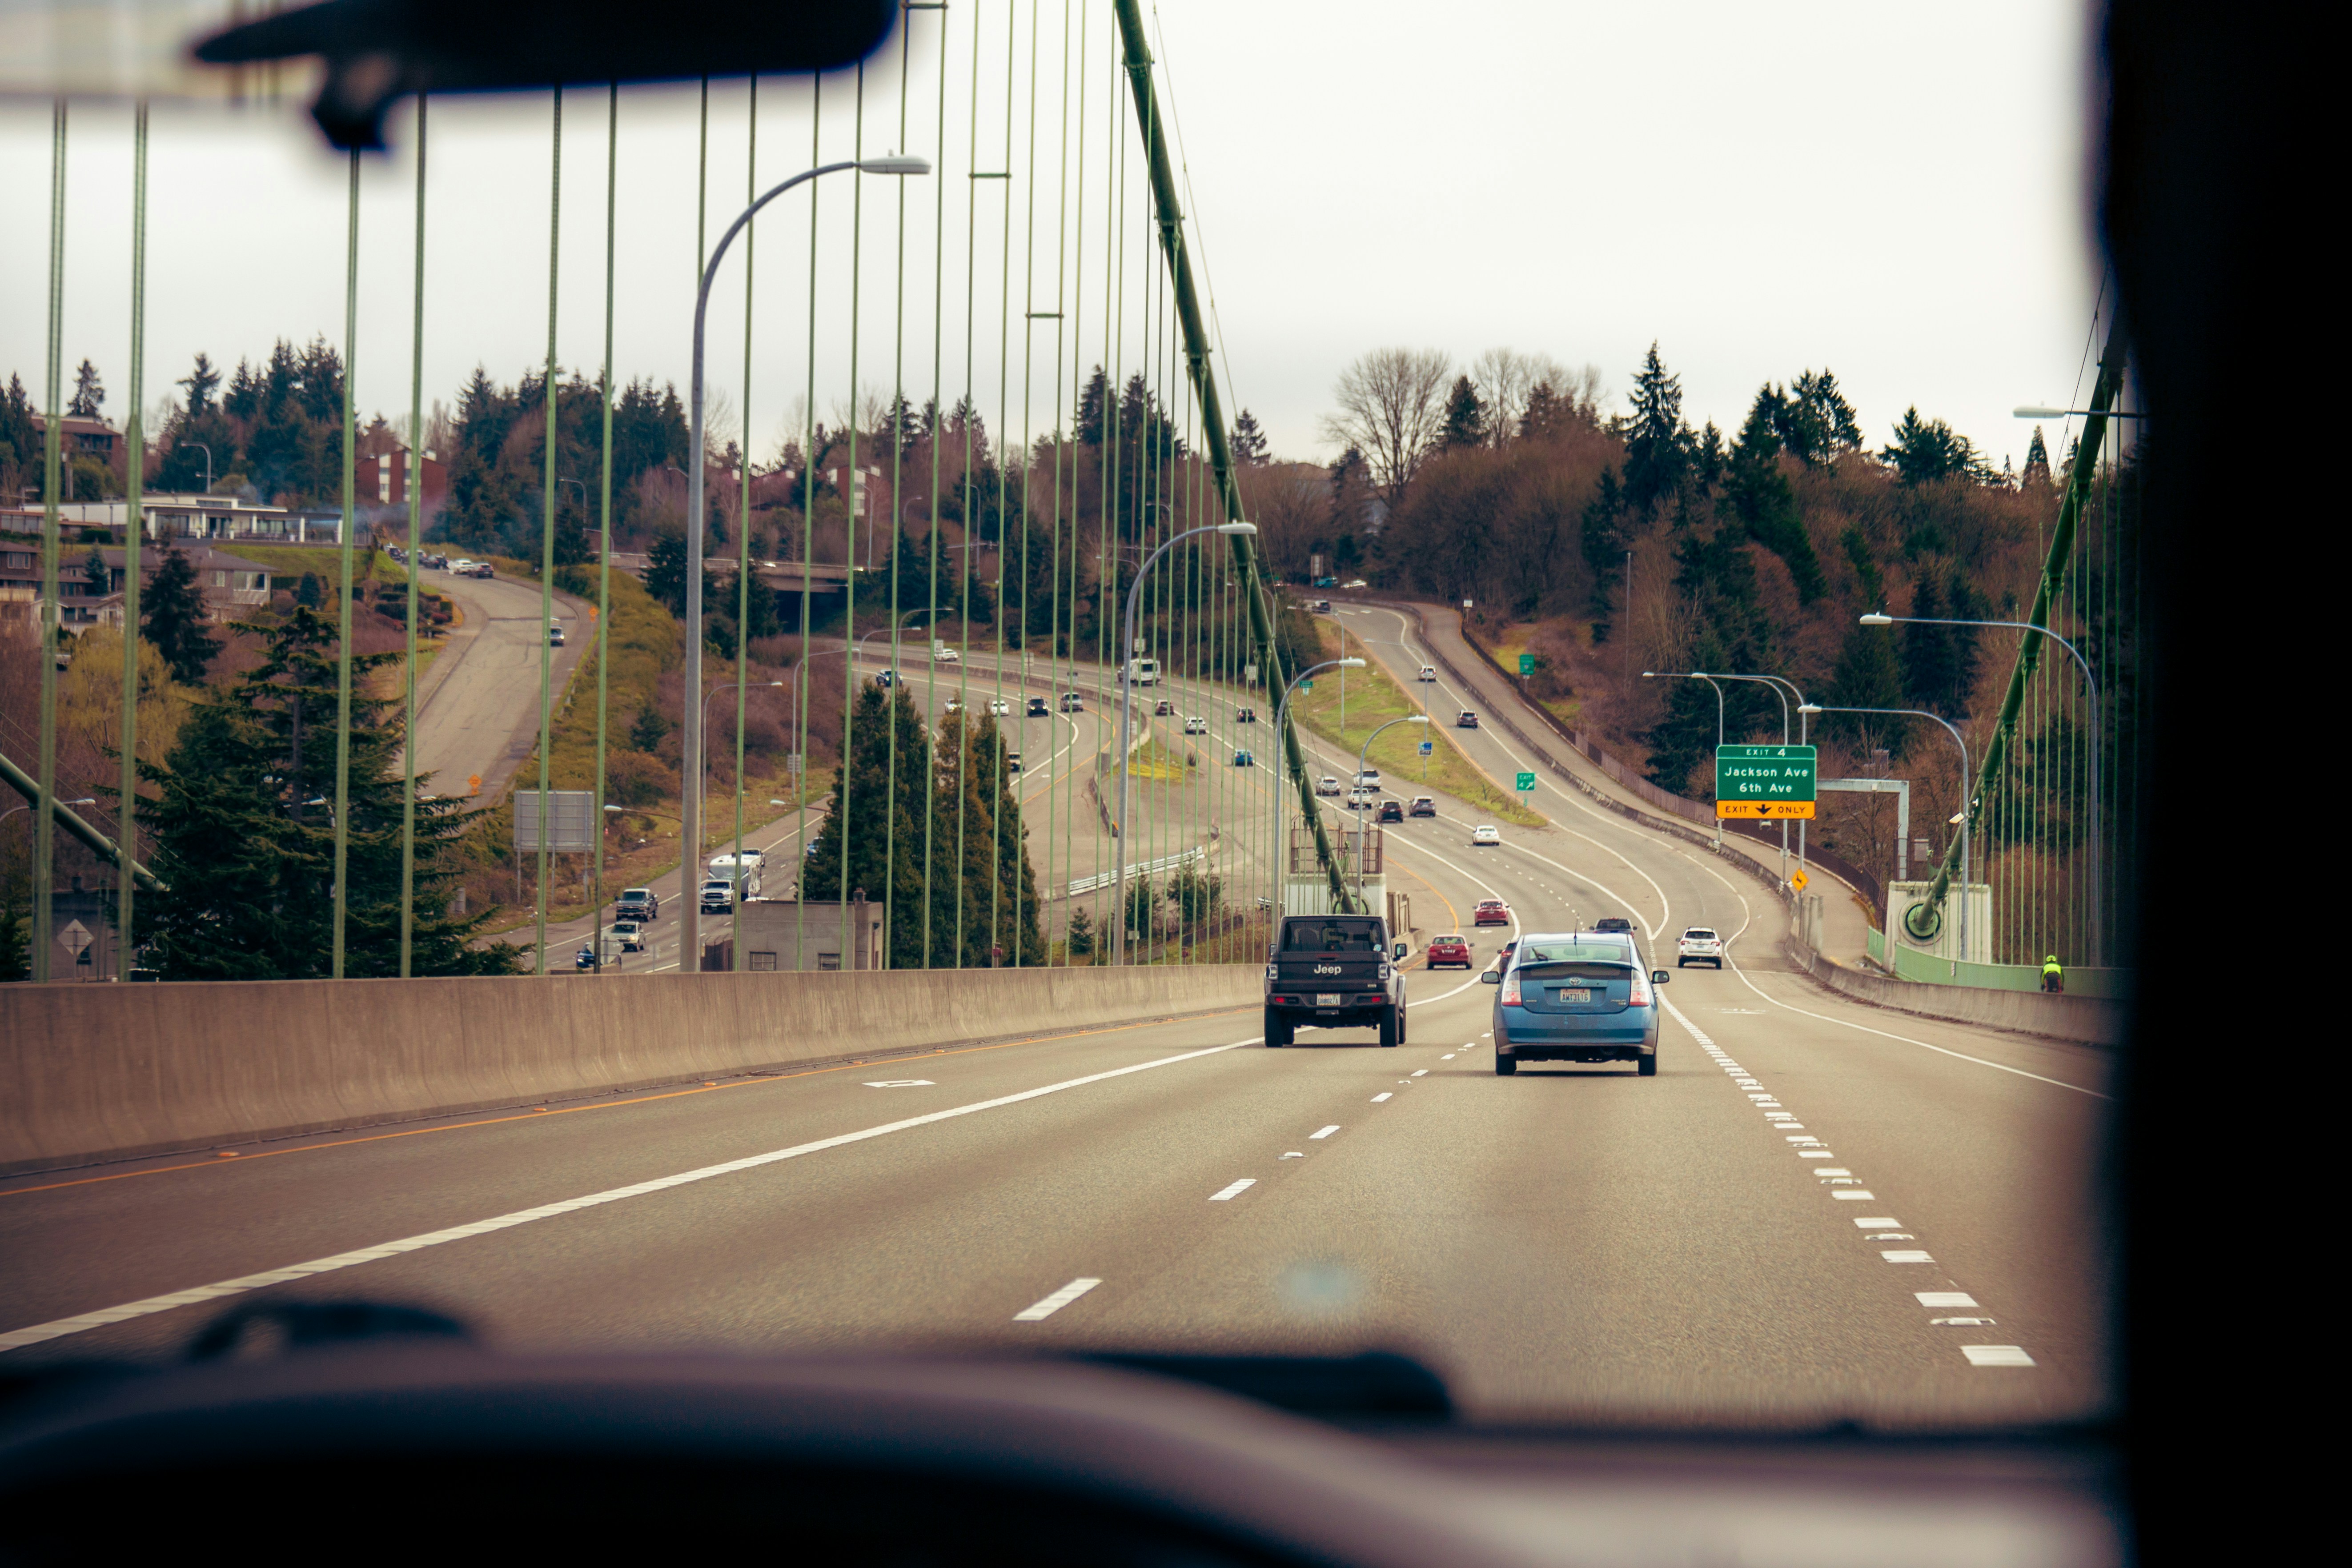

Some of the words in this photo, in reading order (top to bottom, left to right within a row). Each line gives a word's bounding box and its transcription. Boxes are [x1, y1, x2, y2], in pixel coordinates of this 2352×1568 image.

[1777, 748, 1786, 757] 4
[1725, 767, 1777, 777] Jackson
[1785, 767, 1808, 777] Ave
[1739, 782, 1761, 793] 6th
[1769, 783, 1792, 793] Ave
[1314, 964, 1341, 975] Jeep
